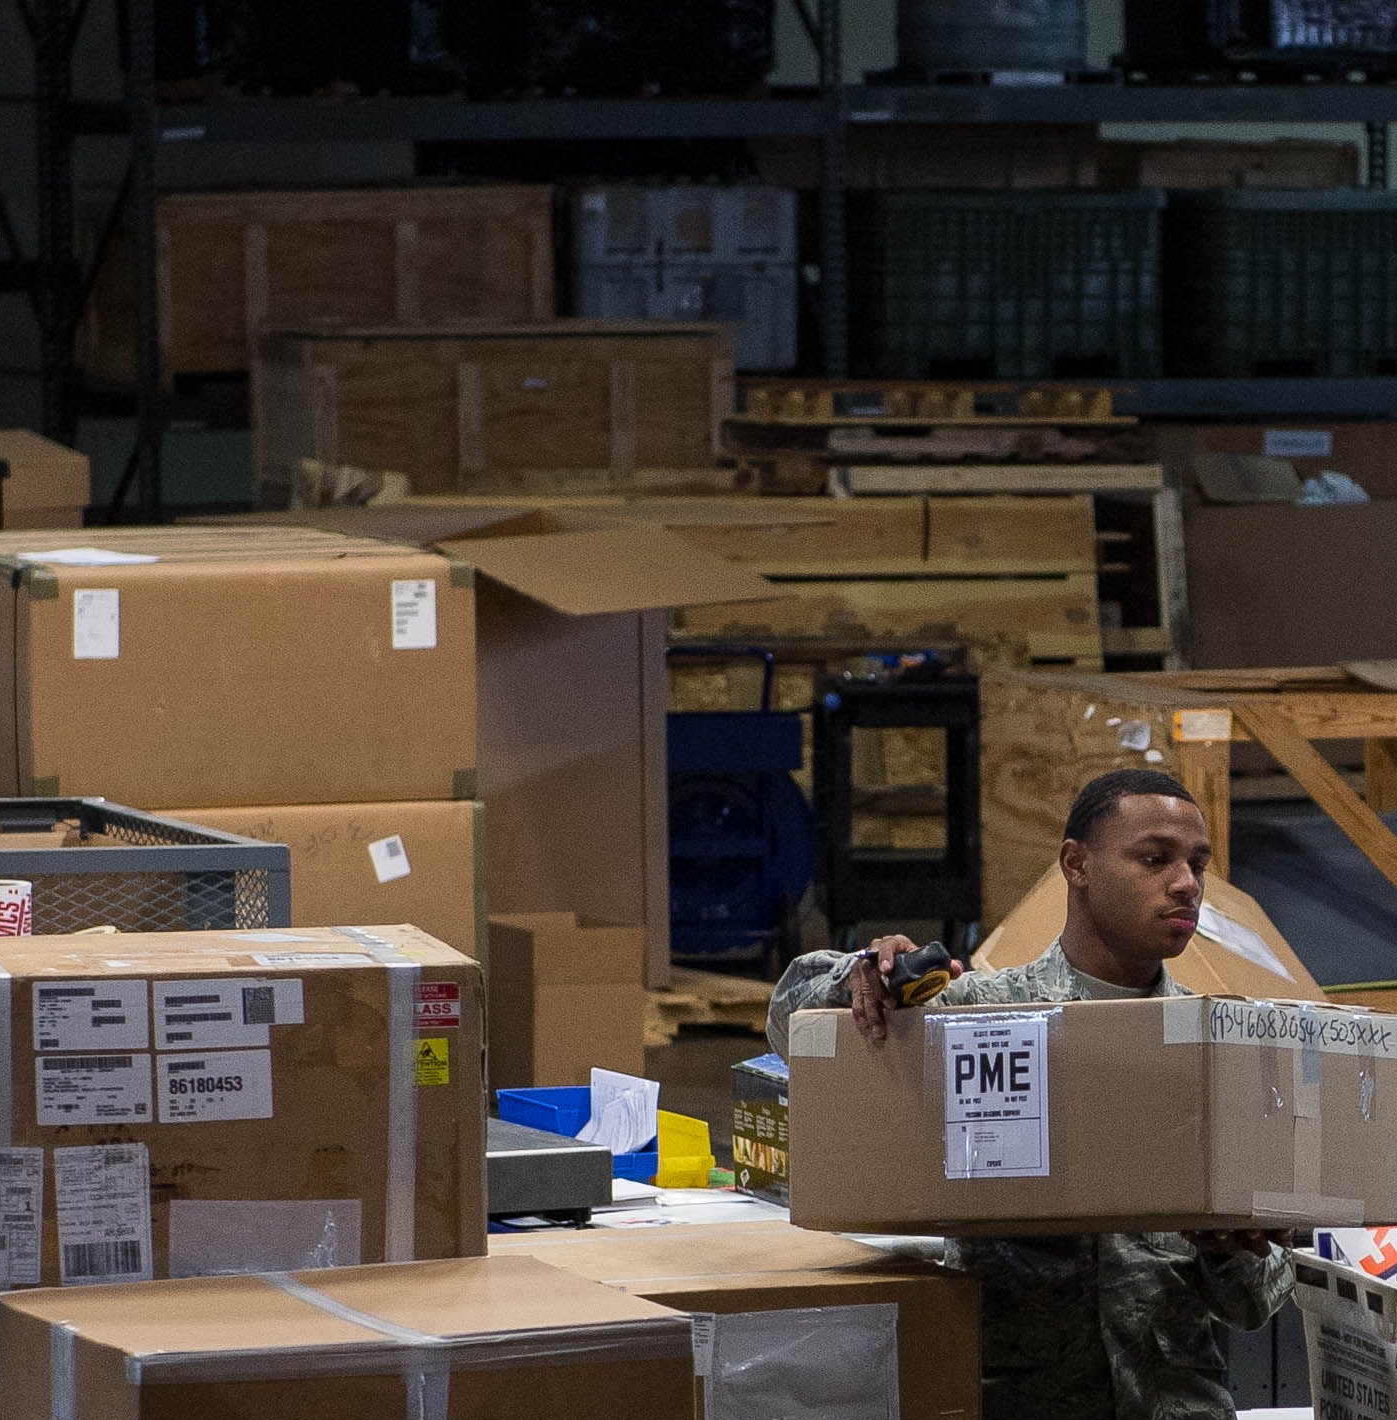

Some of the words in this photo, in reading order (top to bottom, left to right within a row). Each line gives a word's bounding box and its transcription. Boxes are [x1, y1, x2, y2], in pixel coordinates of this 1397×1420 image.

[413, 1003, 451, 1015] LASS
[169, 1076, 243, 1094] 86180453
[955, 1051, 1031, 1094] PME
[1321, 1368, 1354, 1400] UNITED
[1356, 1384, 1390, 1416] STATES
